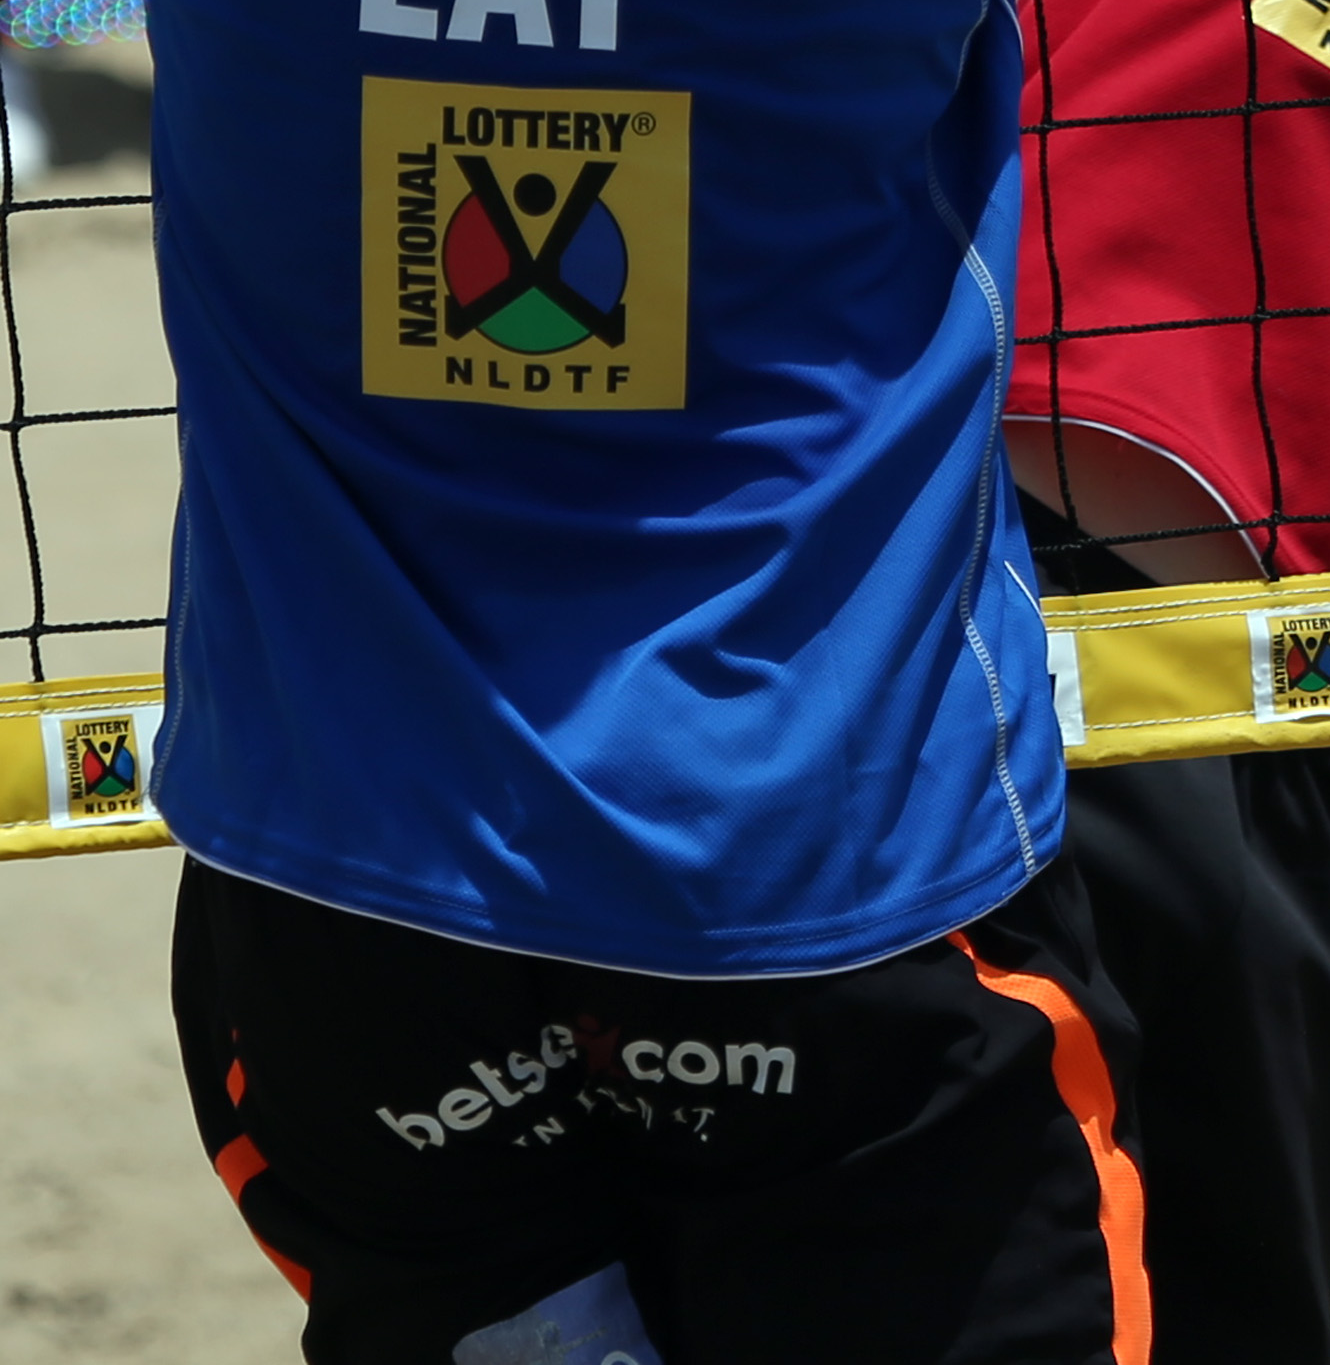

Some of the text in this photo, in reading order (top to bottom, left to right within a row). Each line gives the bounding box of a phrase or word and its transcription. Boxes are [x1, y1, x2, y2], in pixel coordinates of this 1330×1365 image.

[442, 106, 631, 153] LOTTERY
[397, 142, 438, 348] NATIONAL
[445, 356, 631, 394] NLDTF
[1273, 632, 1287, 694] NATIONAL
[76, 720, 130, 737] LOTTERY
[67, 736, 84, 800] NATIONAL
[84, 799, 140, 814] NLDTF
